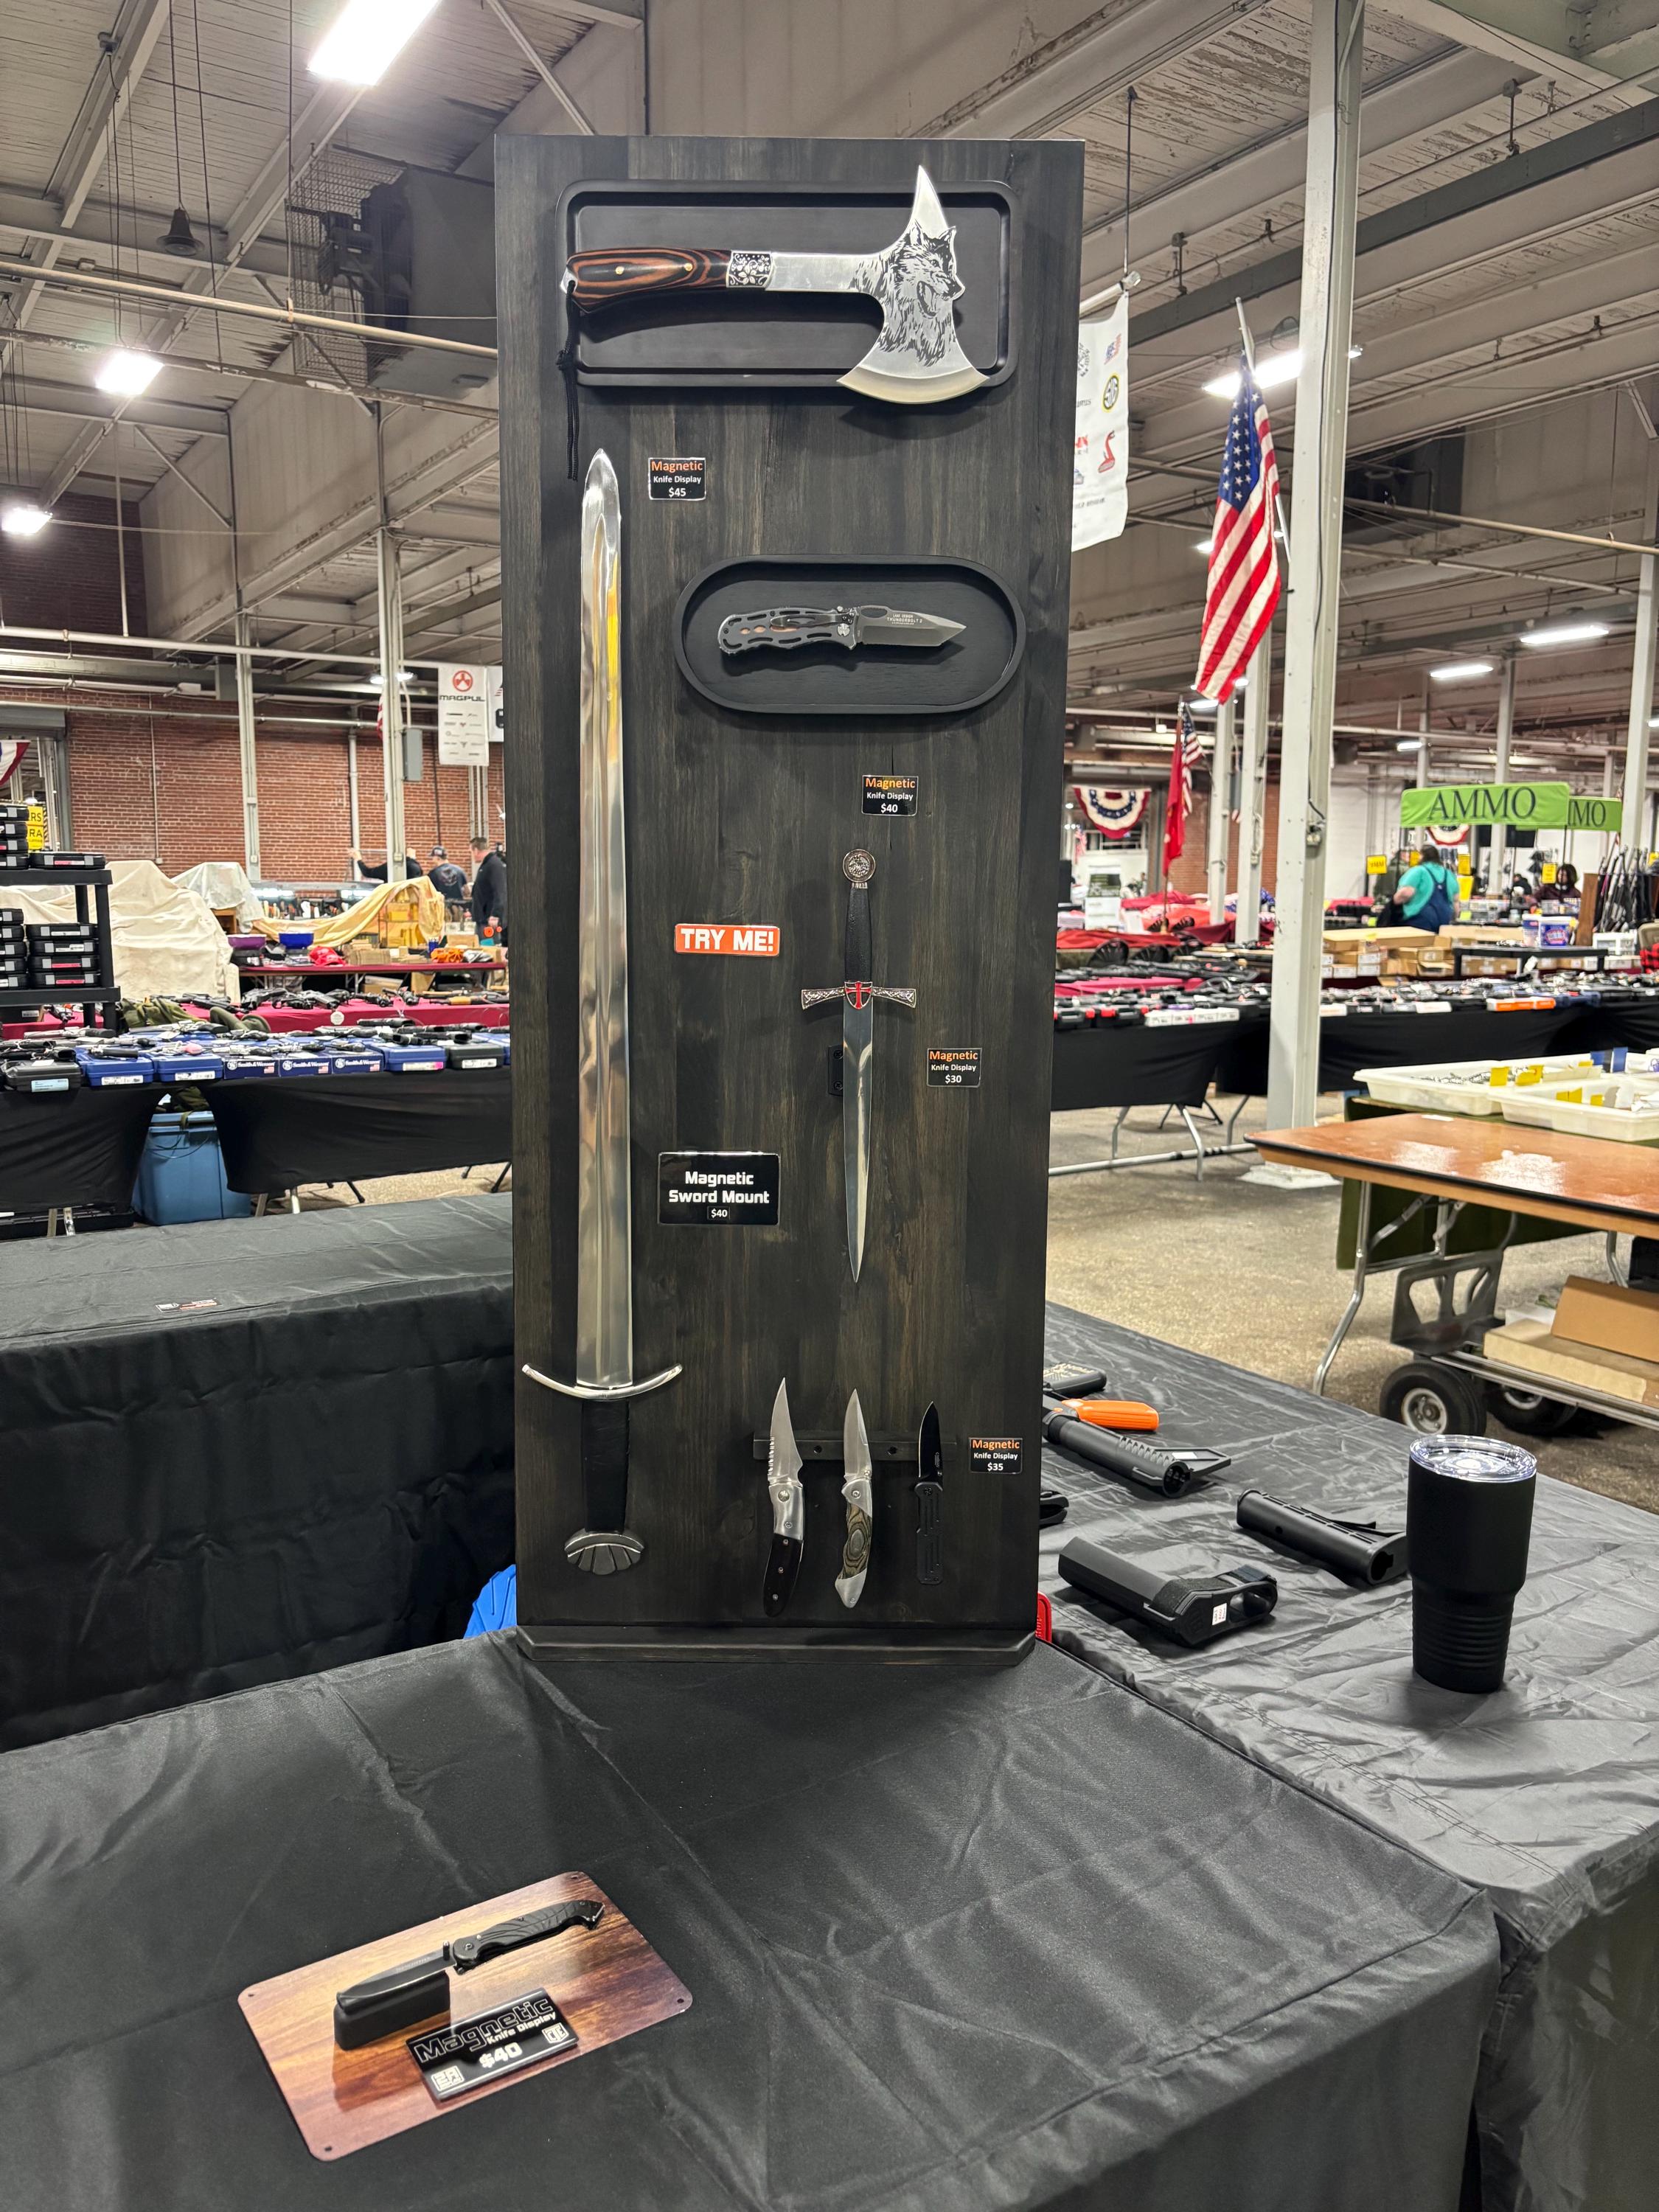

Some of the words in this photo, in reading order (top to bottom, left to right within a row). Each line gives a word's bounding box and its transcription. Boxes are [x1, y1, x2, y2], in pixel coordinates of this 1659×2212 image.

[651, 461, 703, 473] Magnetic
[674, 476, 701, 484] Display
[669, 487, 686, 498] $45
[866, 778, 915, 790] Magnetic
[887, 792, 914, 801] Display
[880, 803, 898, 813] $40
[1427, 787, 1537, 821] AMMO
[681, 928, 726, 950] TRY
[733, 930, 774, 952] ME!
[929, 1051, 978, 1062] Magnetic
[951, 1064, 976, 1072] Display
[945, 1074, 961, 1084] $30
[685, 1172, 754, 1187] Magnetic
[669, 1189, 717, 1203] Sword
[722, 1190, 770, 1203] Mount
[711, 1208, 728, 1218] $40
[973, 1439, 1020, 1450] Magnetic
[987, 1462, 1004, 1471] $35
[414, 1998, 553, 2063] Magnetic
[486, 2028, 516, 2045] Knife
[518, 2011, 557, 2036] Display
[479, 2042, 523, 2068] $40
